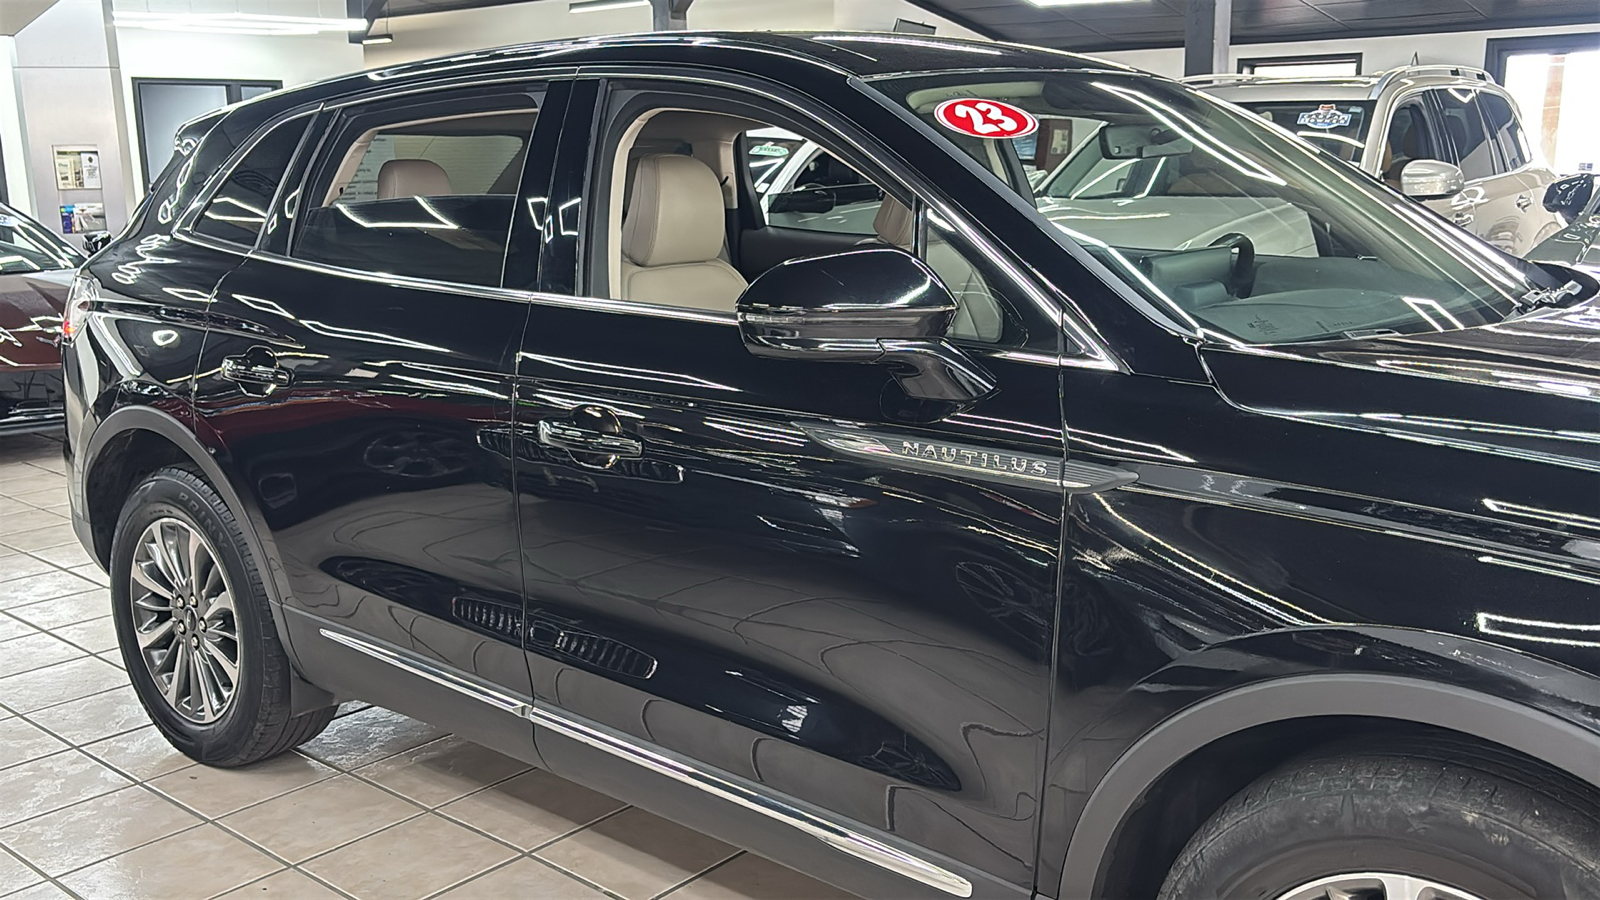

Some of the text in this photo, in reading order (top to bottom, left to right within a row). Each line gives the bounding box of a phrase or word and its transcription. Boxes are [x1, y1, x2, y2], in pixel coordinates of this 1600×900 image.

[954, 102, 1018, 134] 23
[902, 441, 1048, 477] NAUTILUS
[178, 491, 228, 548] PRINX
